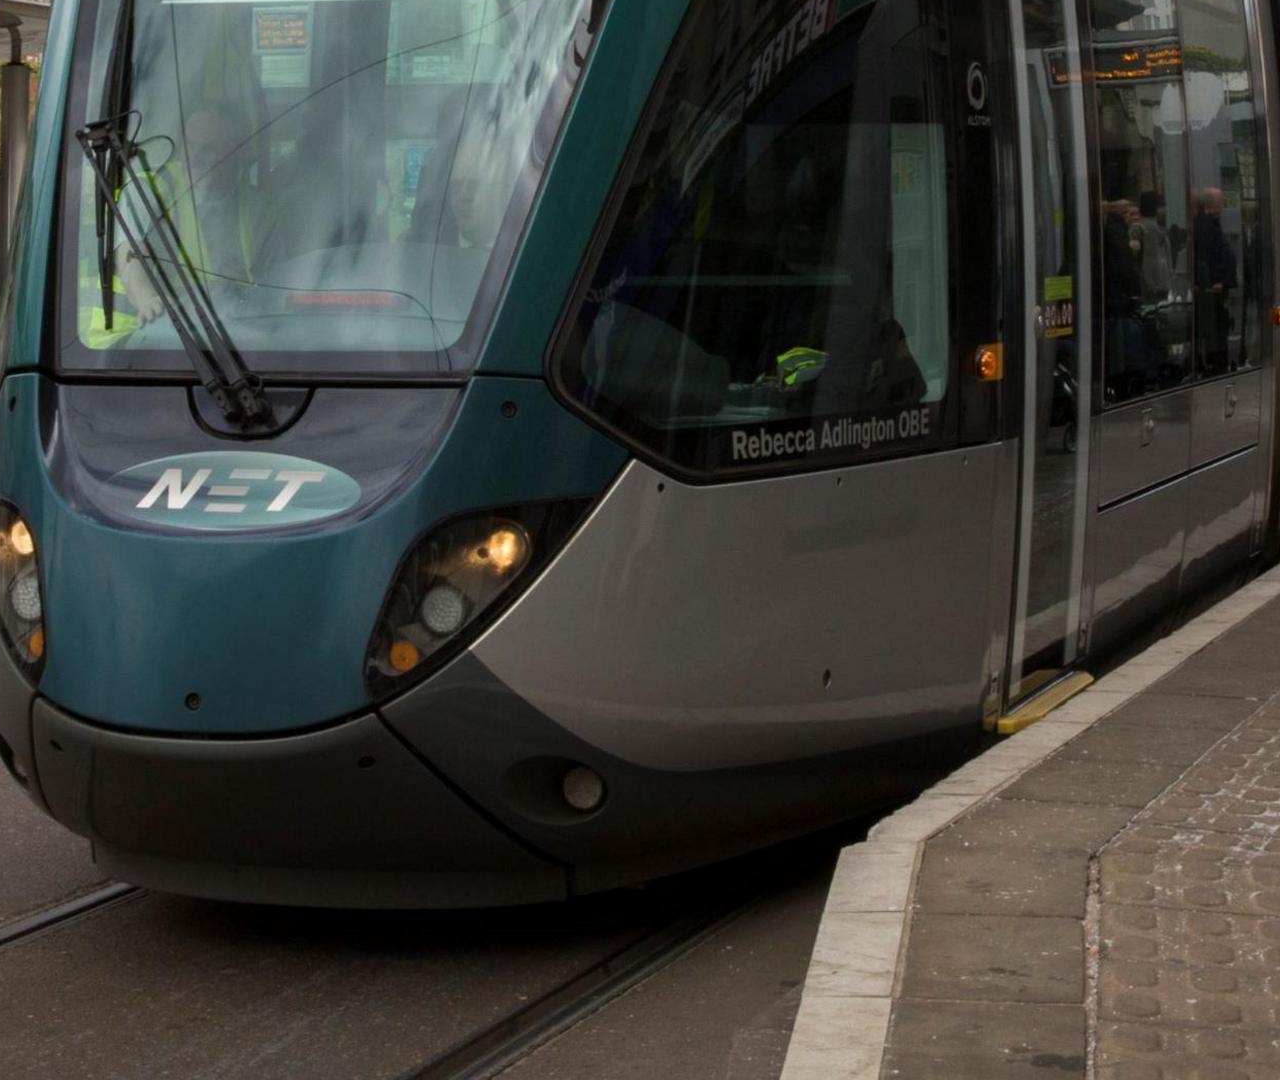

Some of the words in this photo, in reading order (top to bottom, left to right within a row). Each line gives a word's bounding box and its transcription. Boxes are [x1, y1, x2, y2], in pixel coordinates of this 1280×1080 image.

[732, 427, 815, 461] Rebecca
[820, 416, 895, 450] Adlington
[899, 408, 930, 438] OBE
[135, 468, 328, 513] NET
